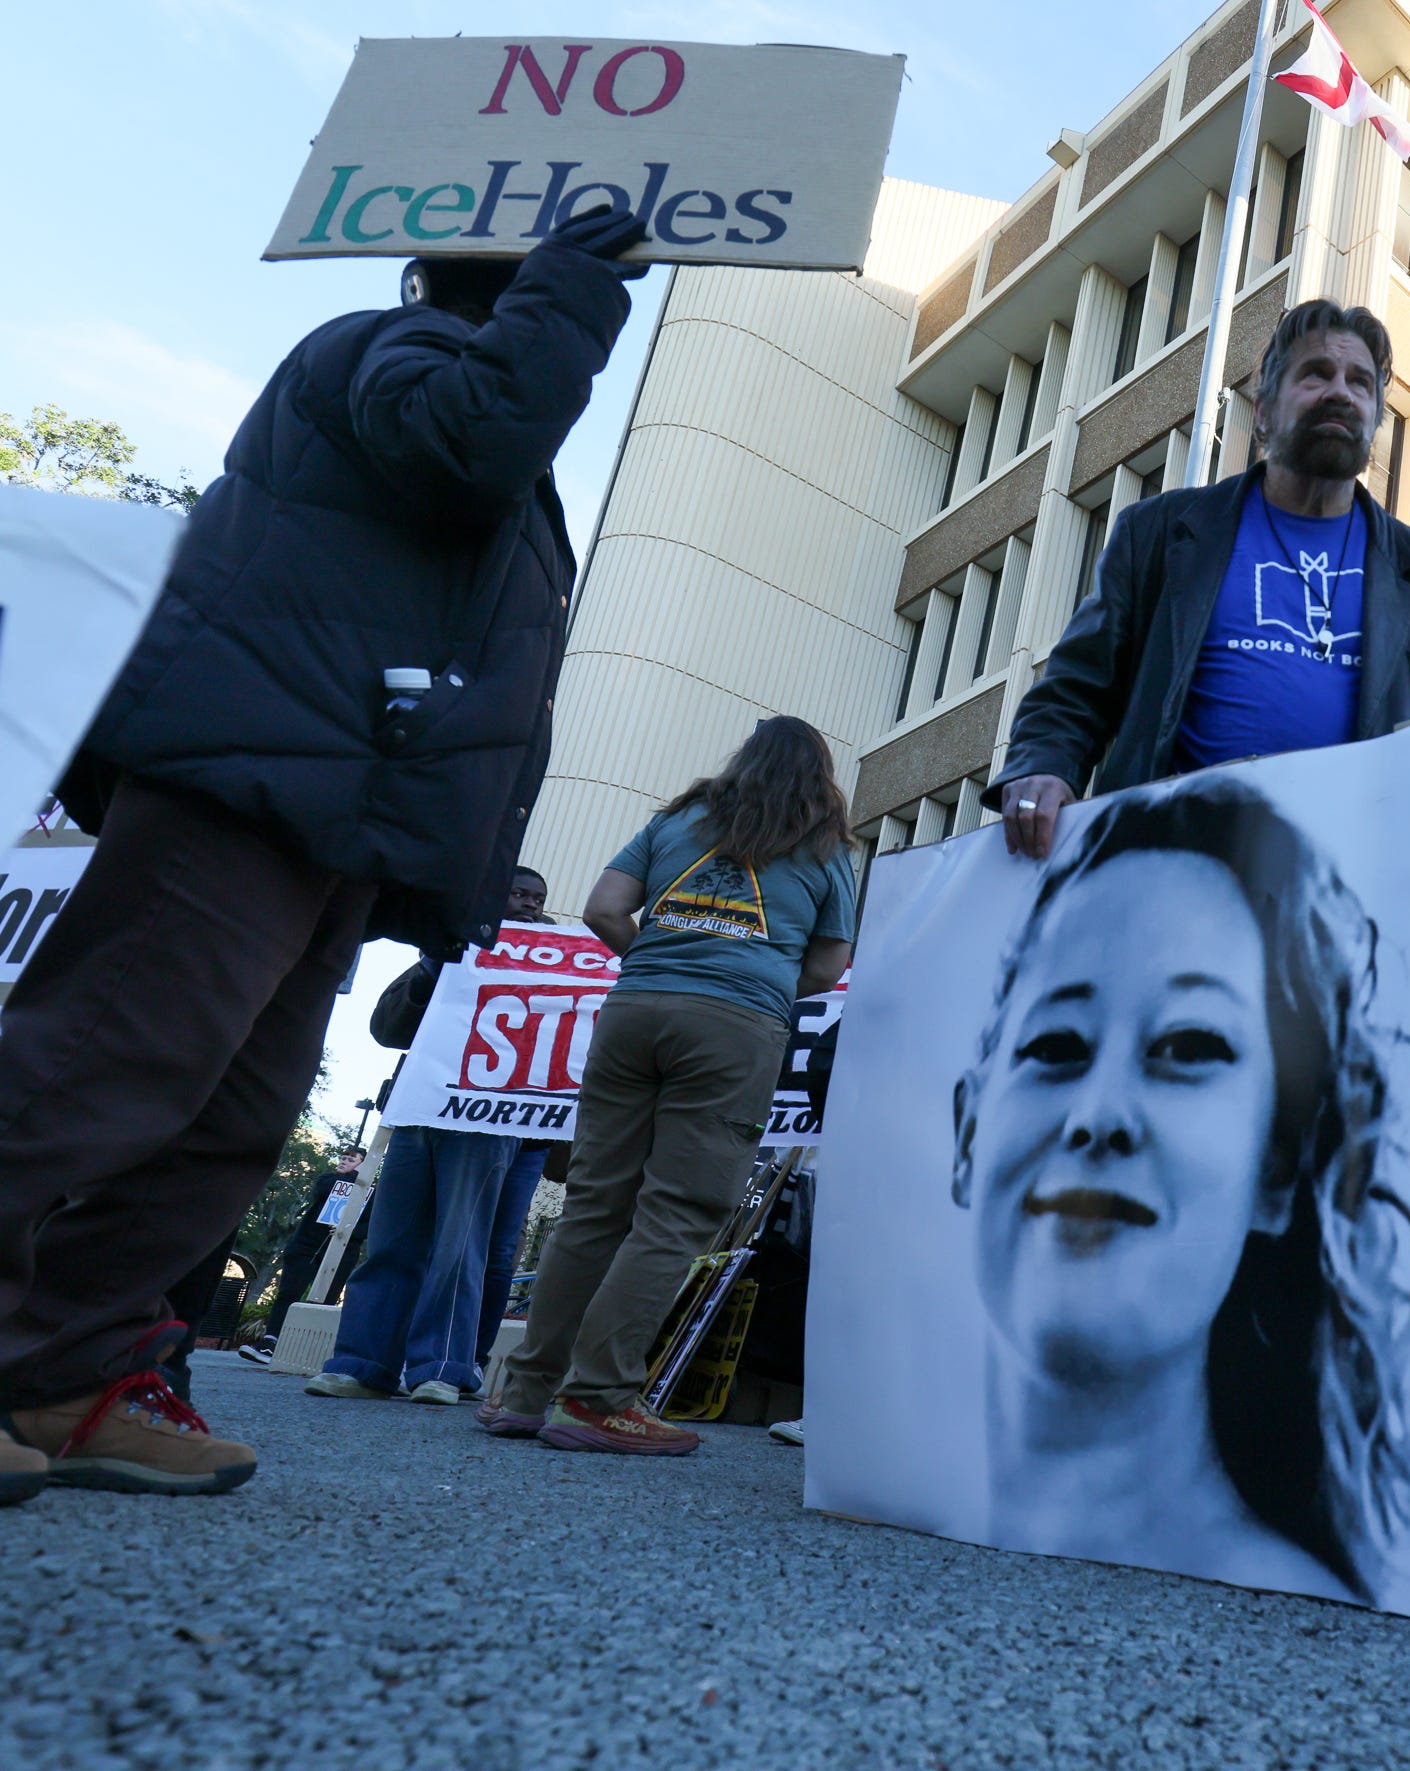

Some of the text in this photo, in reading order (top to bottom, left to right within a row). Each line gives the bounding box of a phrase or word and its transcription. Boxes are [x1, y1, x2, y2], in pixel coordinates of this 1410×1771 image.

[478, 44, 685, 116] NO
[298, 160, 793, 244] IceHoles
[1227, 639, 1295, 653] BOOKS
[1301, 646, 1334, 664] NOT
[702, 918, 751, 938] ALLIANCE
[490, 941, 564, 966] NO
[438, 1095, 573, 1128] NORTH
